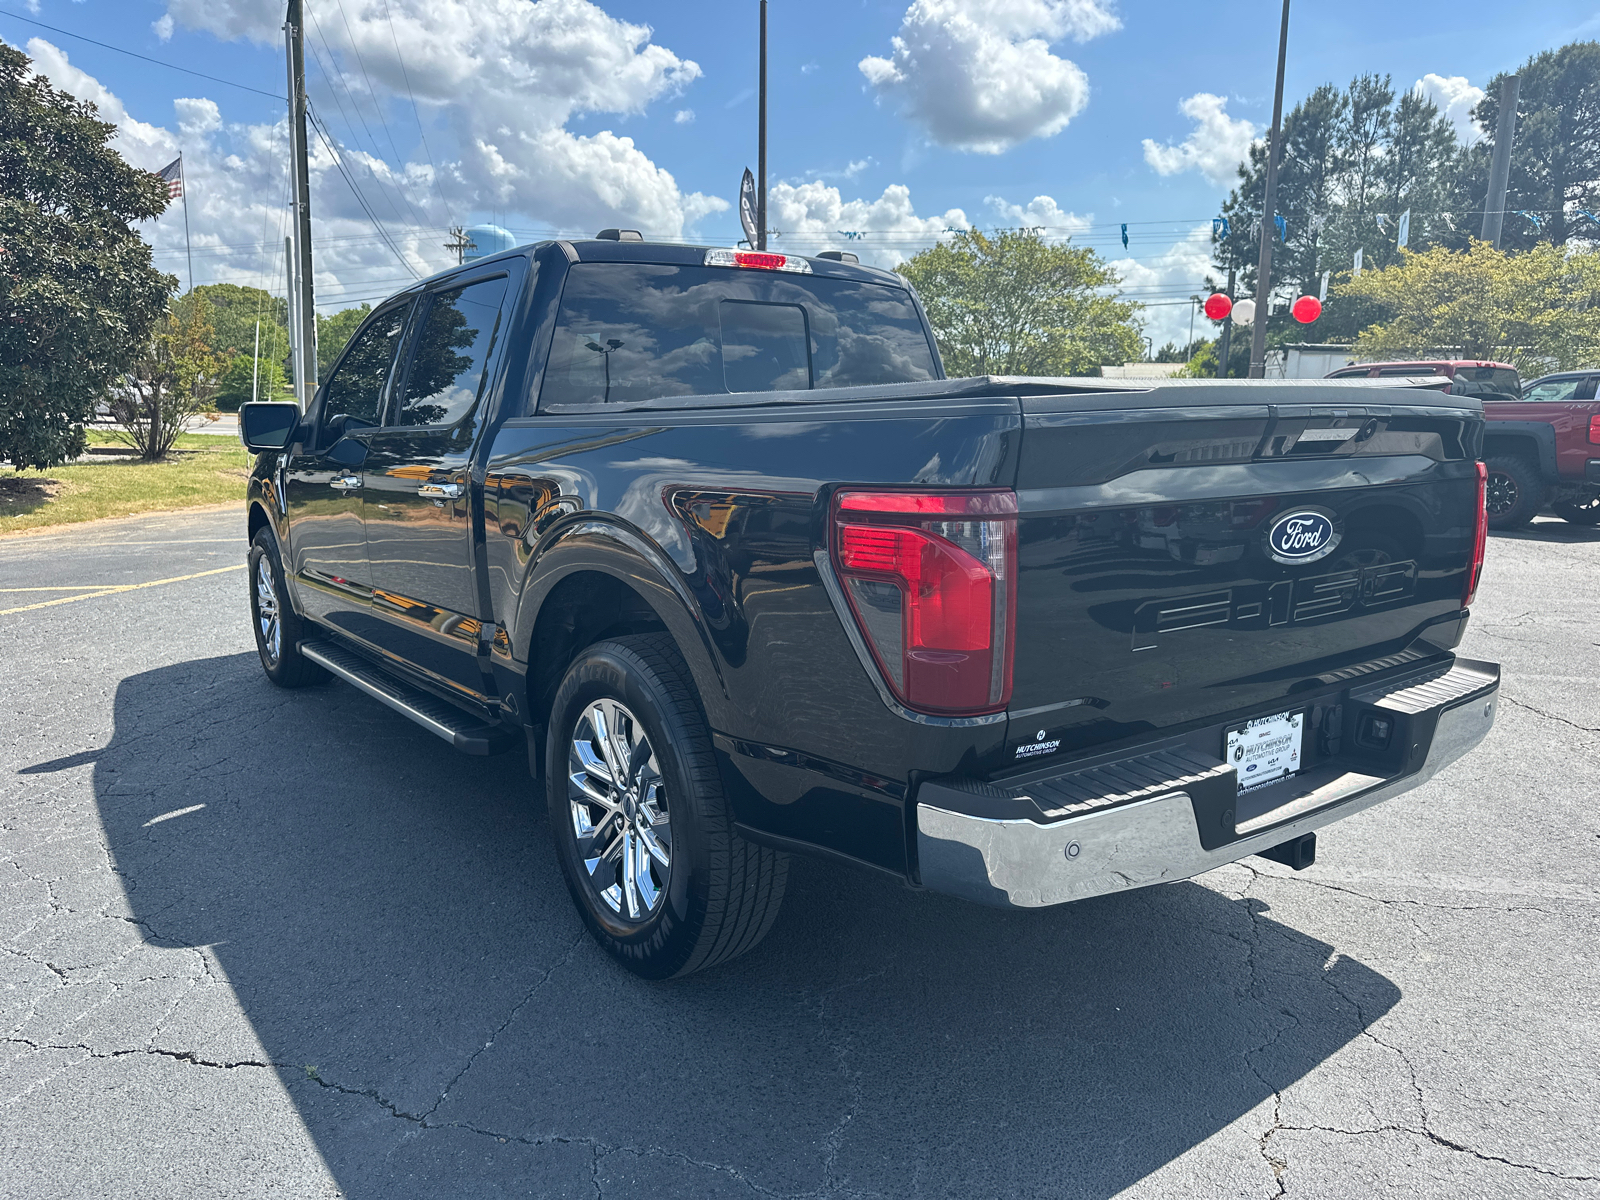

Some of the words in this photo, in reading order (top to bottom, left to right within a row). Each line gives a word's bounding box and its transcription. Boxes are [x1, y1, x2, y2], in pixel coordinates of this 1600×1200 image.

[1281, 518, 1324, 550] Ford
[1131, 559, 1418, 652] F-150
[1245, 733, 1293, 756] HUTCHINSON
[1258, 730, 1271, 738] GMC
[1015, 740, 1060, 754] HUTCHINSON
[1245, 749, 1275, 763] AUTOMOTIVE
[1274, 744, 1290, 754] GROUP
